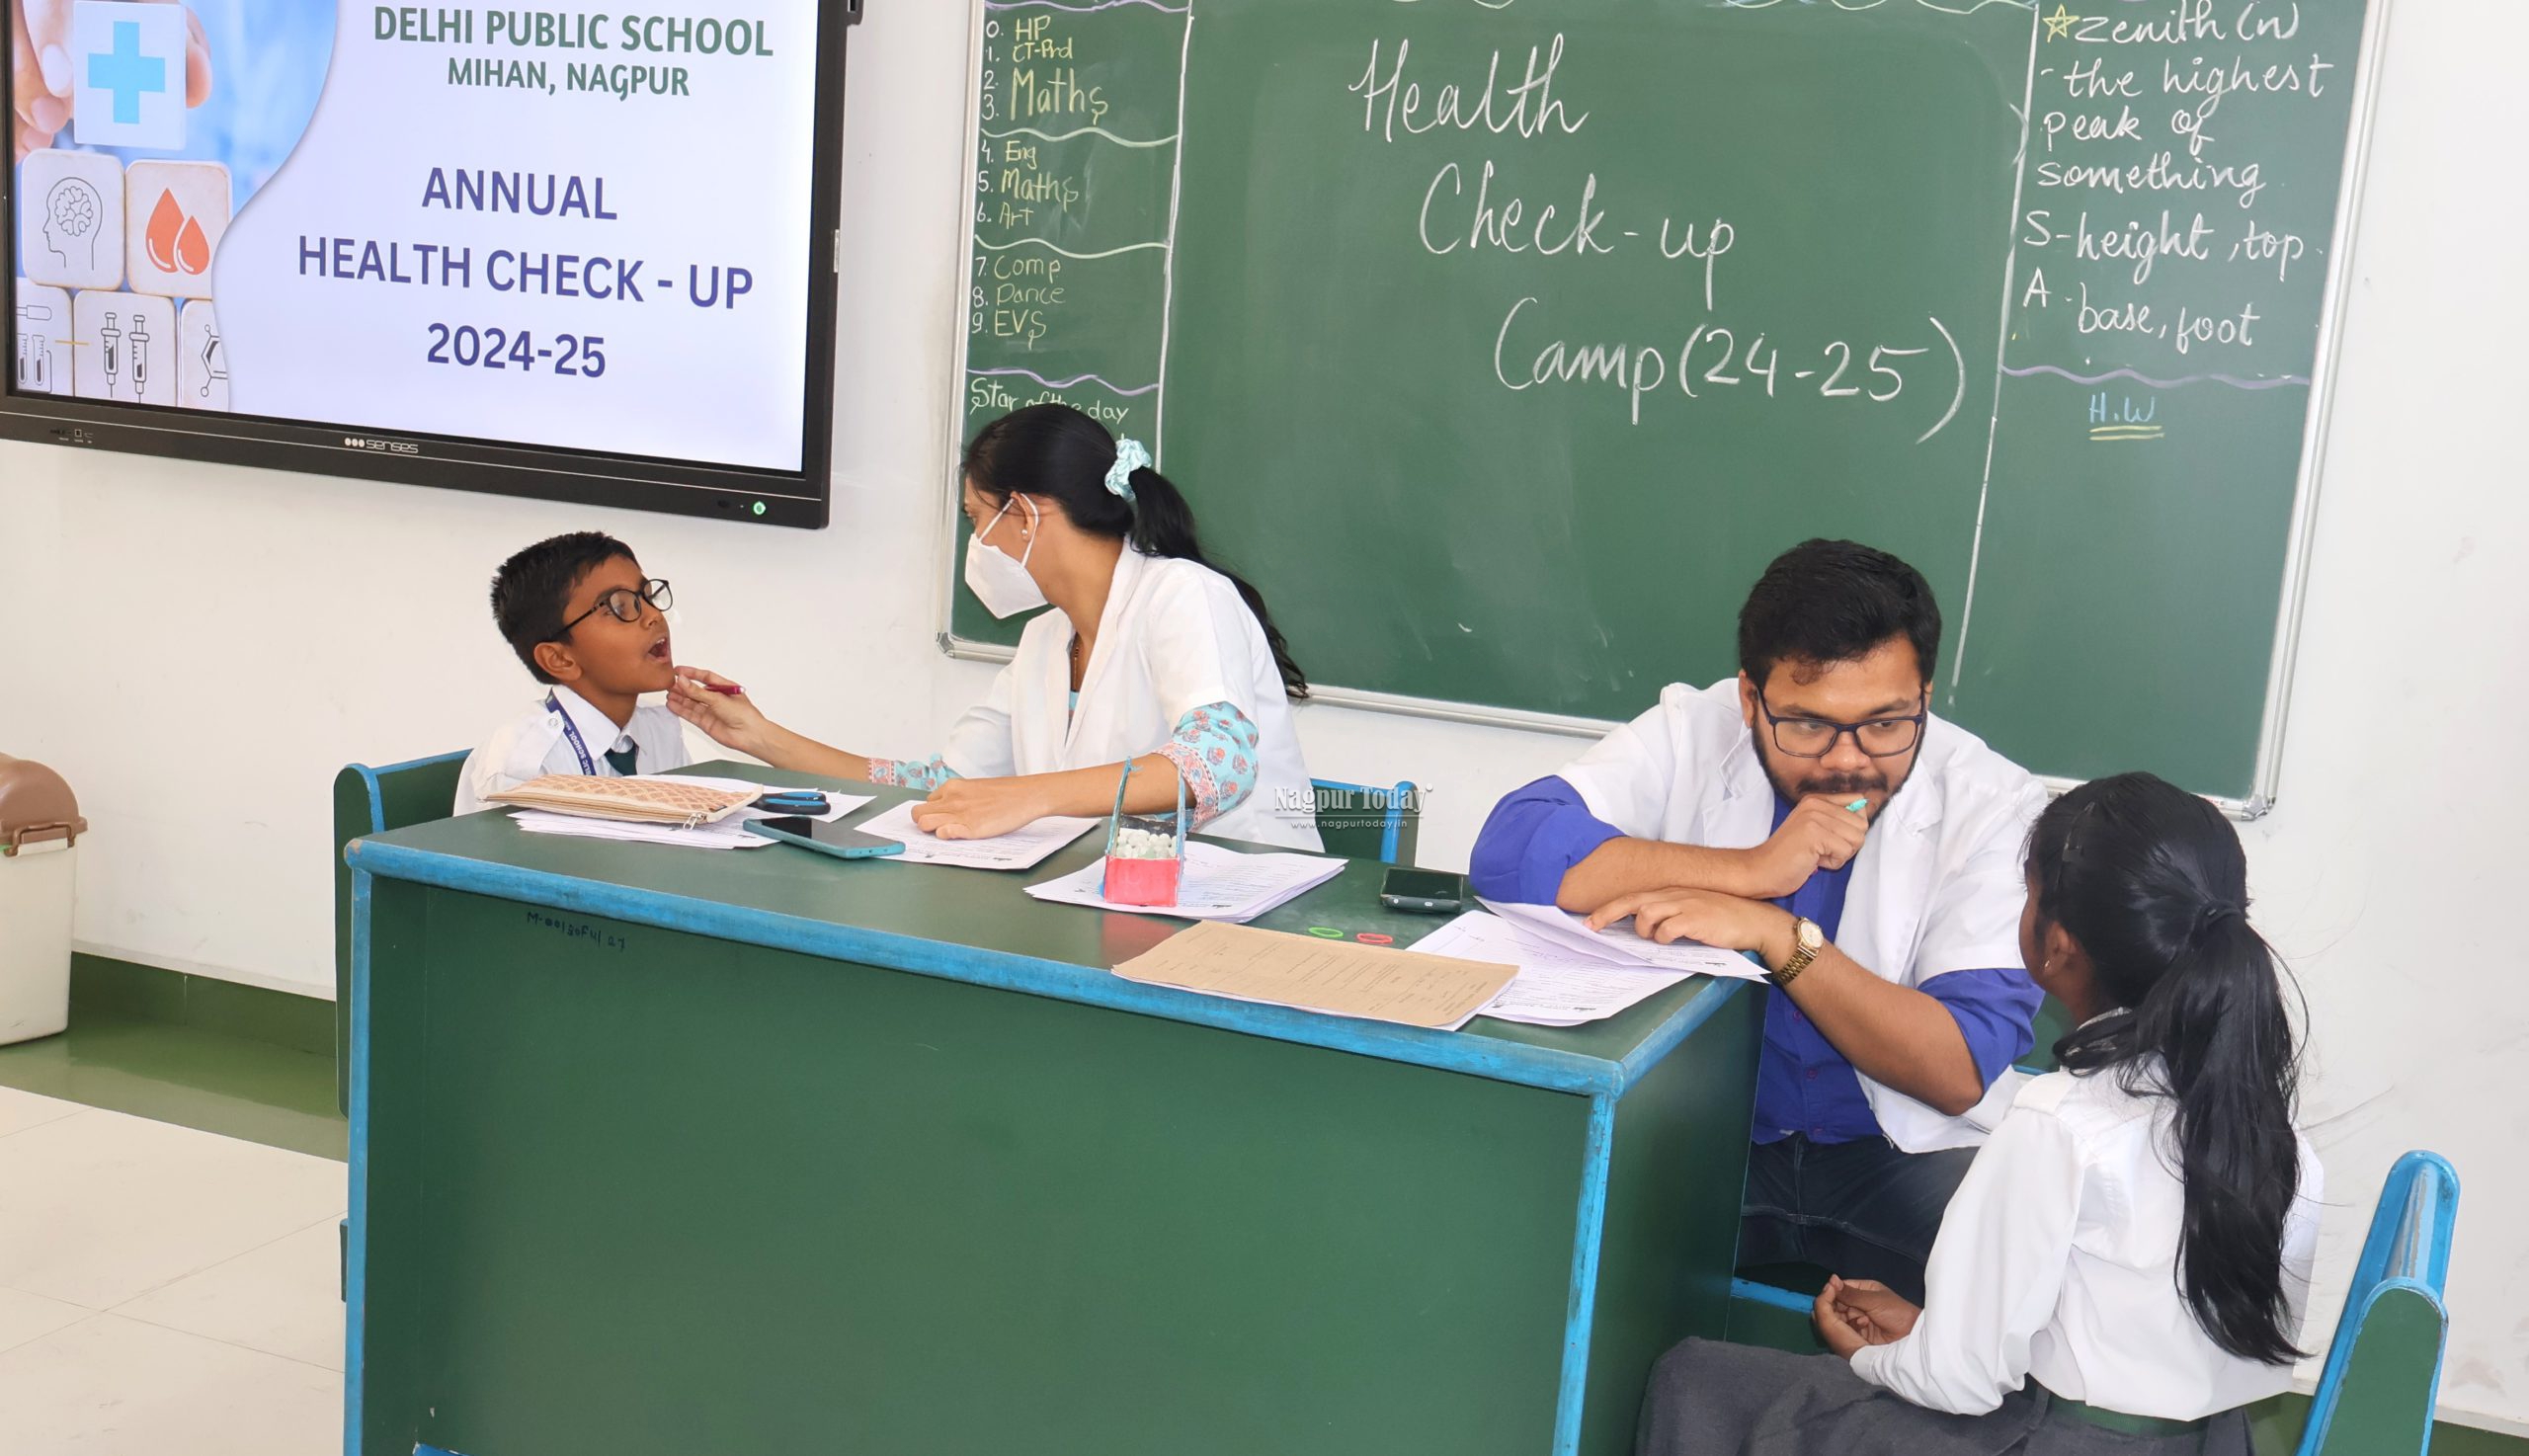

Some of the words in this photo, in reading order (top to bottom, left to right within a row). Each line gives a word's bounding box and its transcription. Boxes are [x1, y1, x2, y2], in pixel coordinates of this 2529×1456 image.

[374, 6, 472, 42] DELHI
[486, 10, 609, 49] PUBLIC
[620, 15, 774, 56] SCHOOL
[1016, 15, 1051, 41] HP
[448, 57, 556, 96] MIHAN,
[566, 62, 690, 102] NAGPUR
[1011, 67, 1108, 125] Maths
[1348, 33, 1589, 142] Health
[2163, 53, 2334, 119] highest
[1006, 140, 1037, 170] Eng
[2171, 110, 2215, 155] of
[422, 167, 617, 220] ANNUAL
[1001, 168, 1079, 212] Maths
[2037, 151, 2266, 208] something
[999, 202, 1034, 230] Art
[298, 235, 470, 288] HEALTH
[486, 249, 644, 302] CHECK
[690, 264, 754, 309] UP
[994, 255, 1061, 283] Comp
[997, 283, 1066, 305] Dance
[427, 322, 607, 378] 2024-25
[995, 309, 1047, 351] EVS
[969, 377, 1019, 415] Star
[1088, 400, 1129, 425] day
[367, 440, 418, 453] senses
